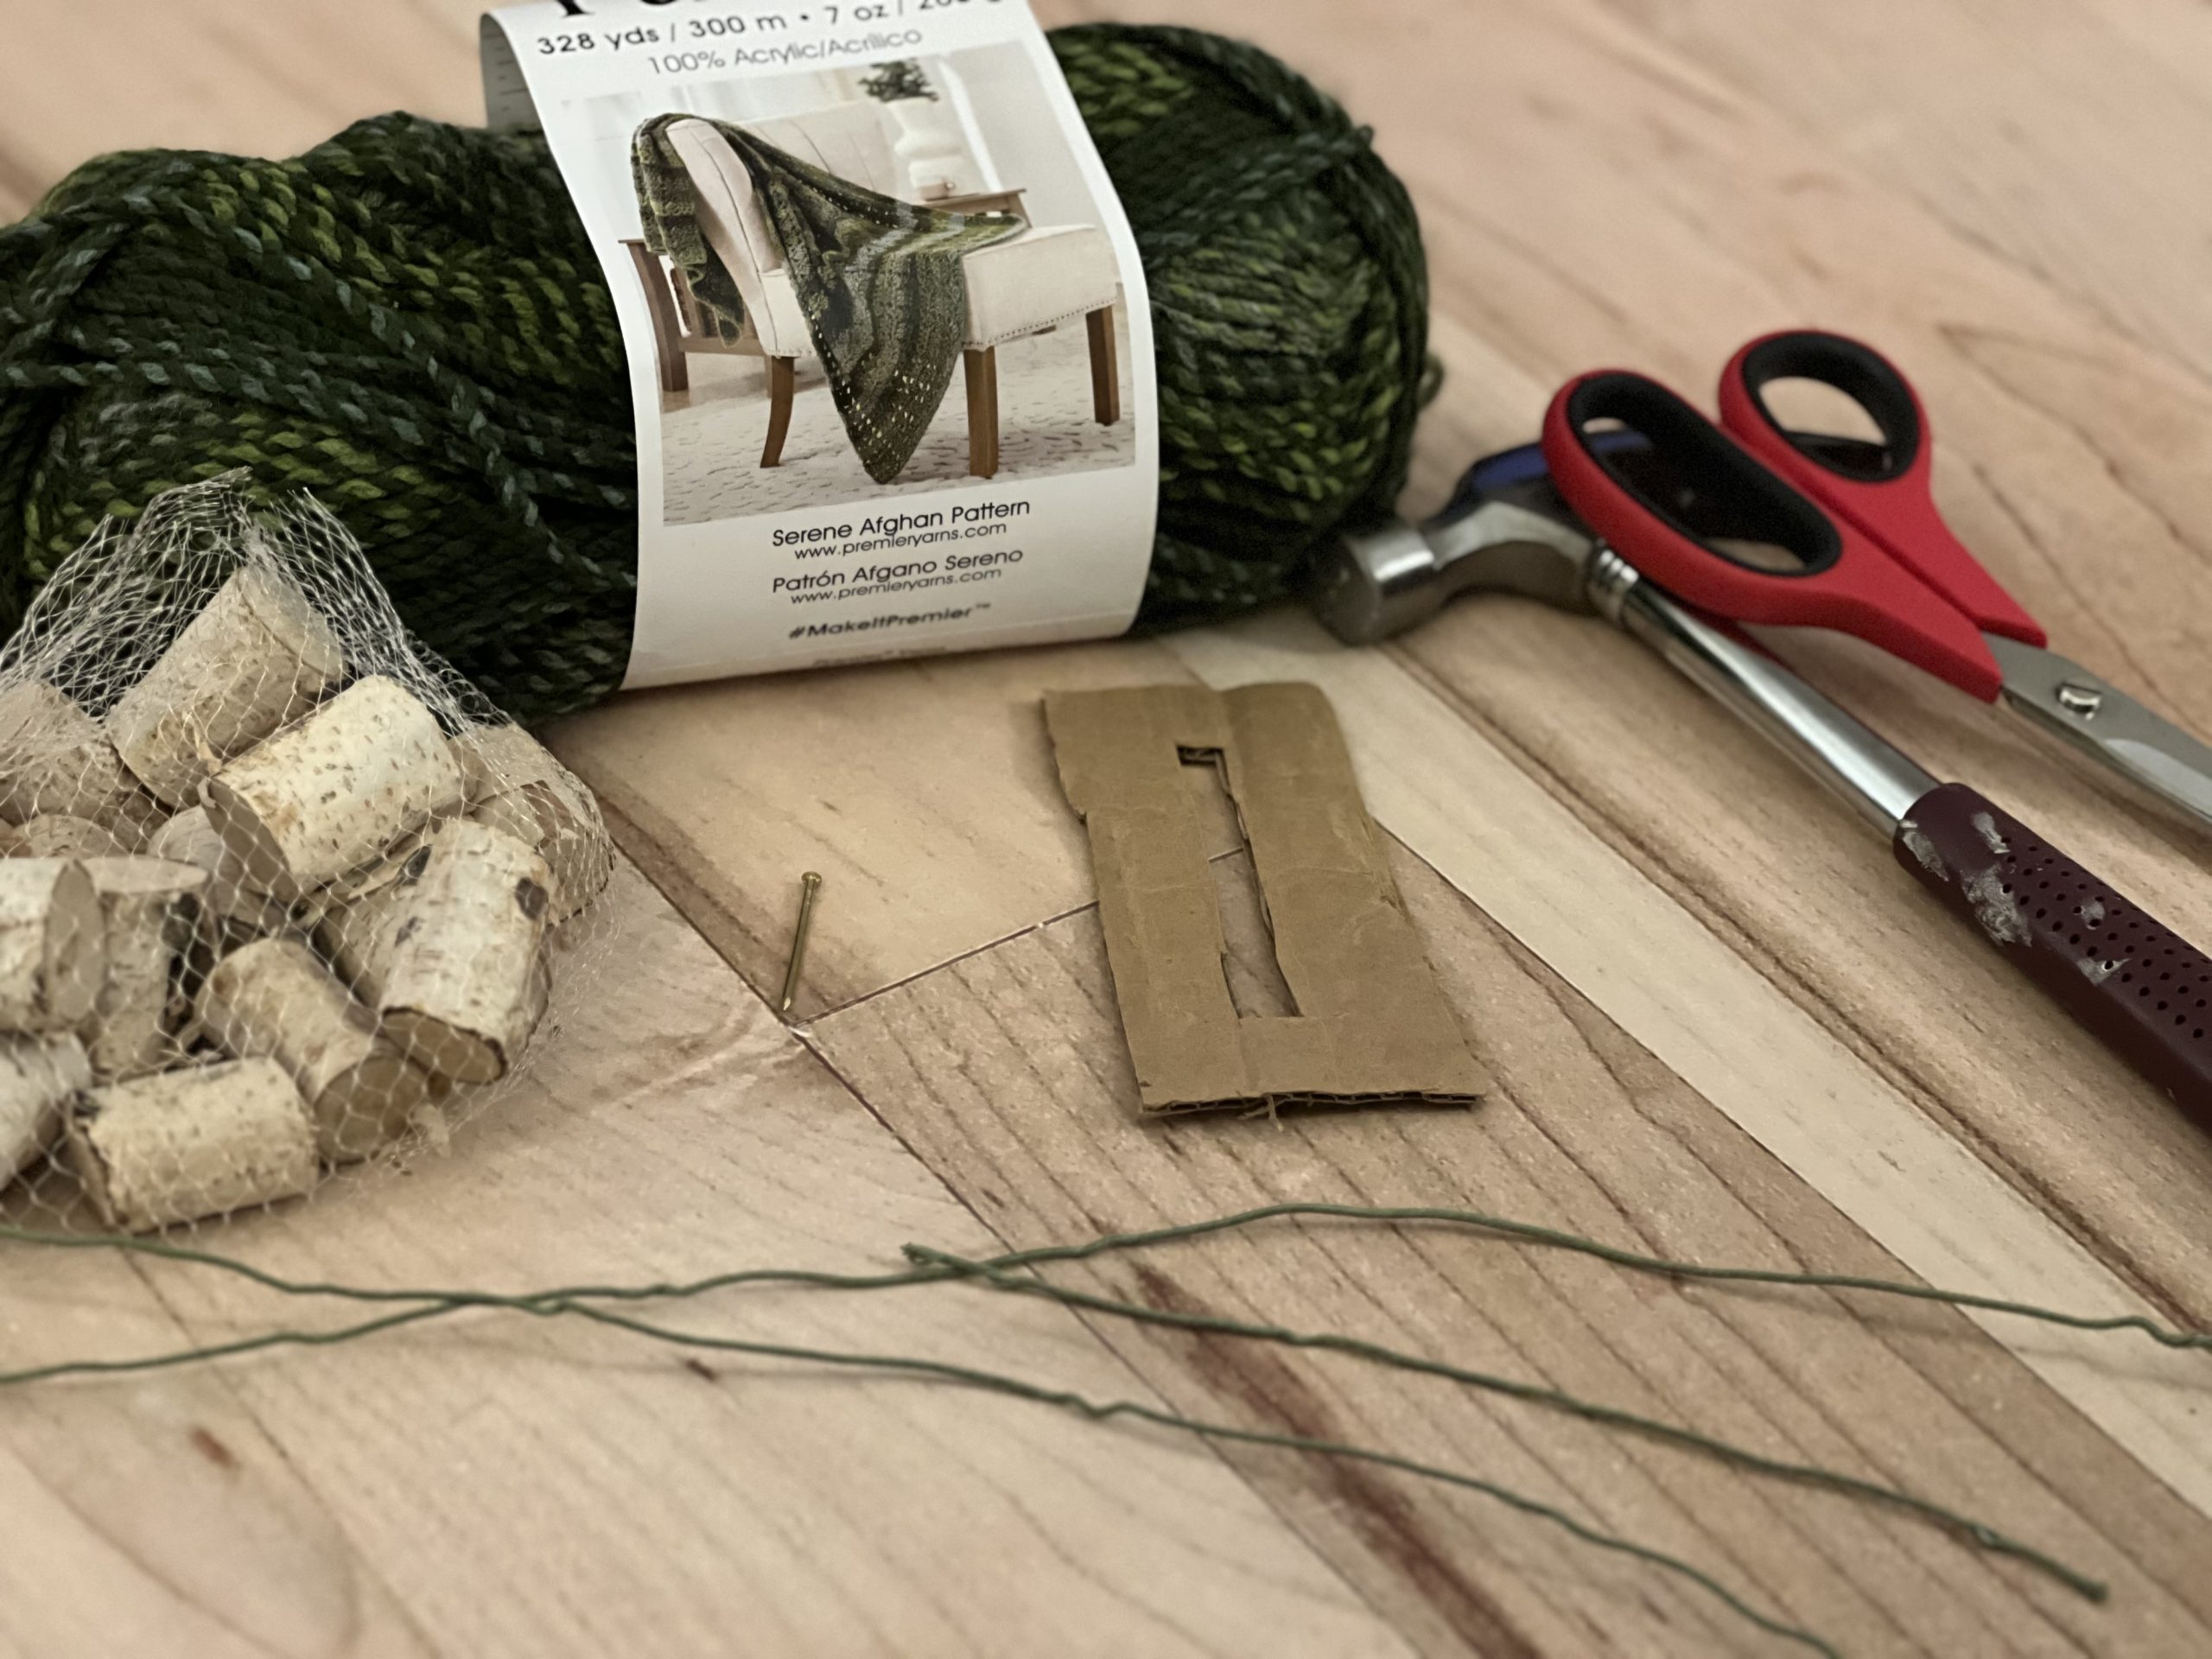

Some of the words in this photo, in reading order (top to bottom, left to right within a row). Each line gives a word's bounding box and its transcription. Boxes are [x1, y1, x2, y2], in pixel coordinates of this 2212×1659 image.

[537, 33, 596, 55] 328
[604, 26, 659, 52] yds
[689, 16, 746, 38] 300
[757, 15, 787, 31] m
[824, 7, 838, 24] 7
[854, 5, 889, 22] oz
[648, 51, 726, 74] 100%
[772, 524, 853, 546] Serene
[859, 512, 944, 537] Afghan
[951, 501, 1031, 524] Pattern
[794, 523, 1007, 560] www.premieryarns.com
[772, 569, 846, 594] Patrón
[852, 560, 938, 583] Afgano
[944, 550, 1024, 570] Sereno
[791, 568, 1002, 604] www.premieryarns.com
